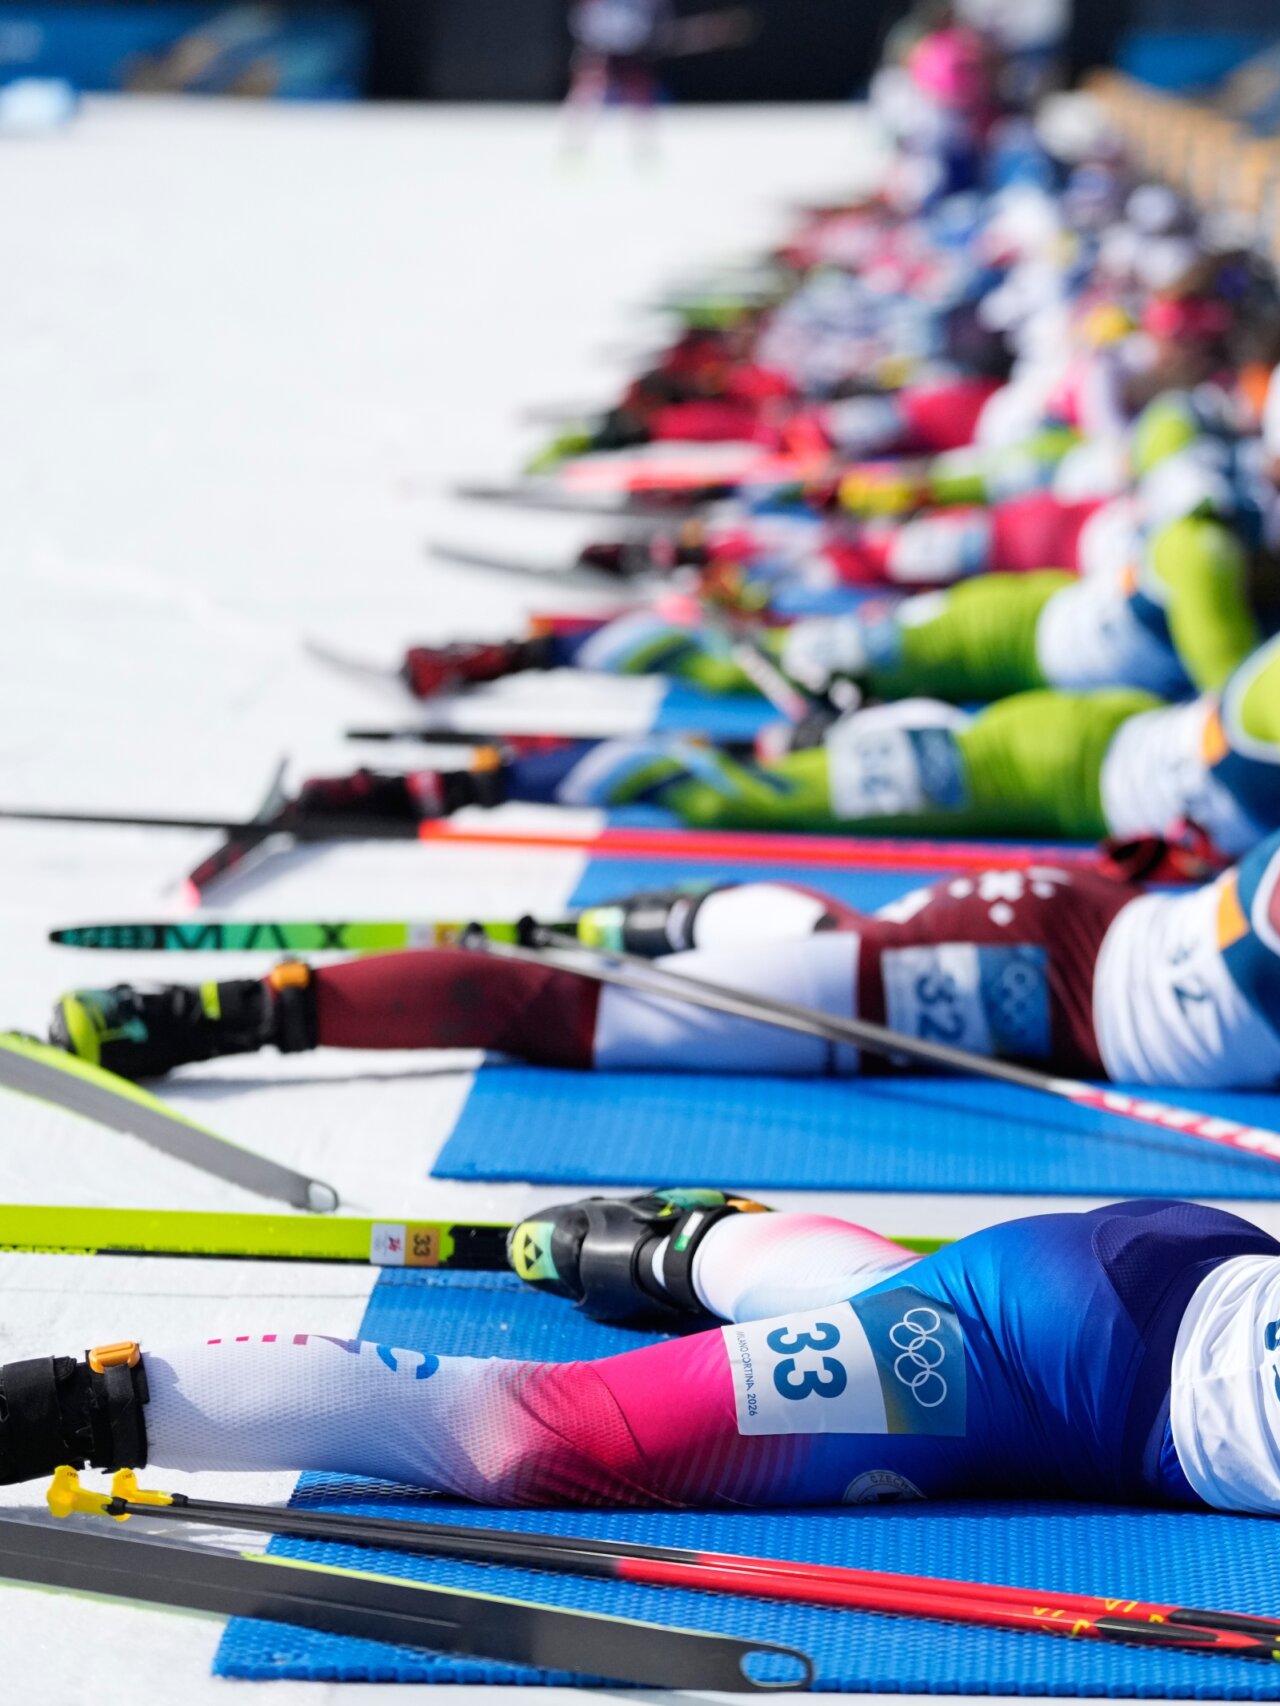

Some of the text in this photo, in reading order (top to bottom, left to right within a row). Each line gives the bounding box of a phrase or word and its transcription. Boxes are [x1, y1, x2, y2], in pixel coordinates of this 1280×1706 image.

[914, 972, 967, 1042] 32
[412, 1232, 432, 1257] 33
[741, 1353, 755, 1391] CORTINA
[766, 1322, 848, 1401] 33
[747, 1393, 759, 1417] 2026
